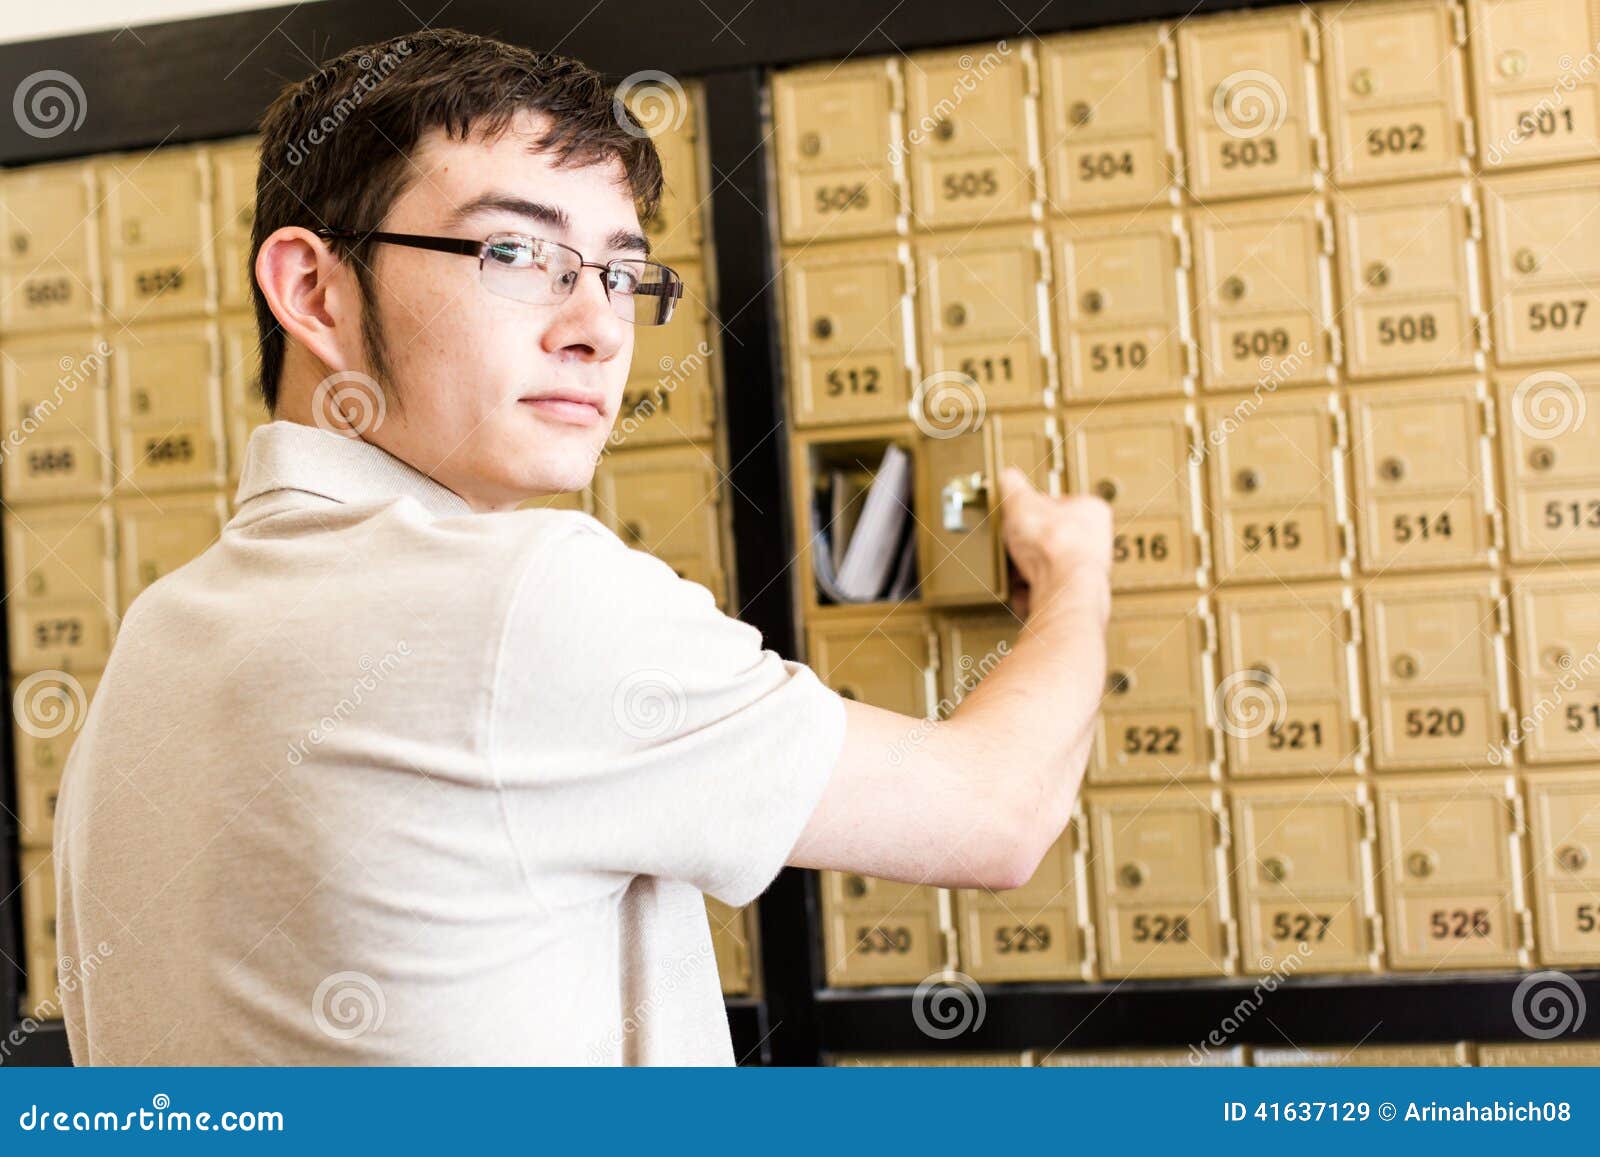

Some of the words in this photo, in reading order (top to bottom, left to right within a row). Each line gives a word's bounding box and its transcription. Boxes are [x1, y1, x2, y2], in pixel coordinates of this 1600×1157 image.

[1220, 138, 1278, 169] 503
[1367, 125, 1426, 156] 502
[1079, 152, 1134, 182] 504
[815, 184, 869, 213] 506
[943, 170, 998, 200] 505
[1378, 315, 1437, 346] 508
[1528, 301, 1588, 332] 507
[1091, 343, 1147, 372] 510
[1232, 329, 1289, 360] 509
[826, 366, 880, 396] 512
[960, 357, 1013, 385] 511
[1393, 513, 1453, 543] 514
[1545, 501, 1600, 529] 513
[1113, 533, 1169, 563] 516
[1243, 522, 1301, 551] 515
[1406, 709, 1466, 737] 520
[1566, 704, 1600, 732] 51
[1124, 727, 1182, 756] 522
[1267, 722, 1323, 752] 521
[1132, 916, 1190, 944] 528
[1272, 912, 1331, 942] 527
[1430, 910, 1492, 939] 526
[856, 927, 912, 955] 530
[995, 926, 1052, 954] 529
